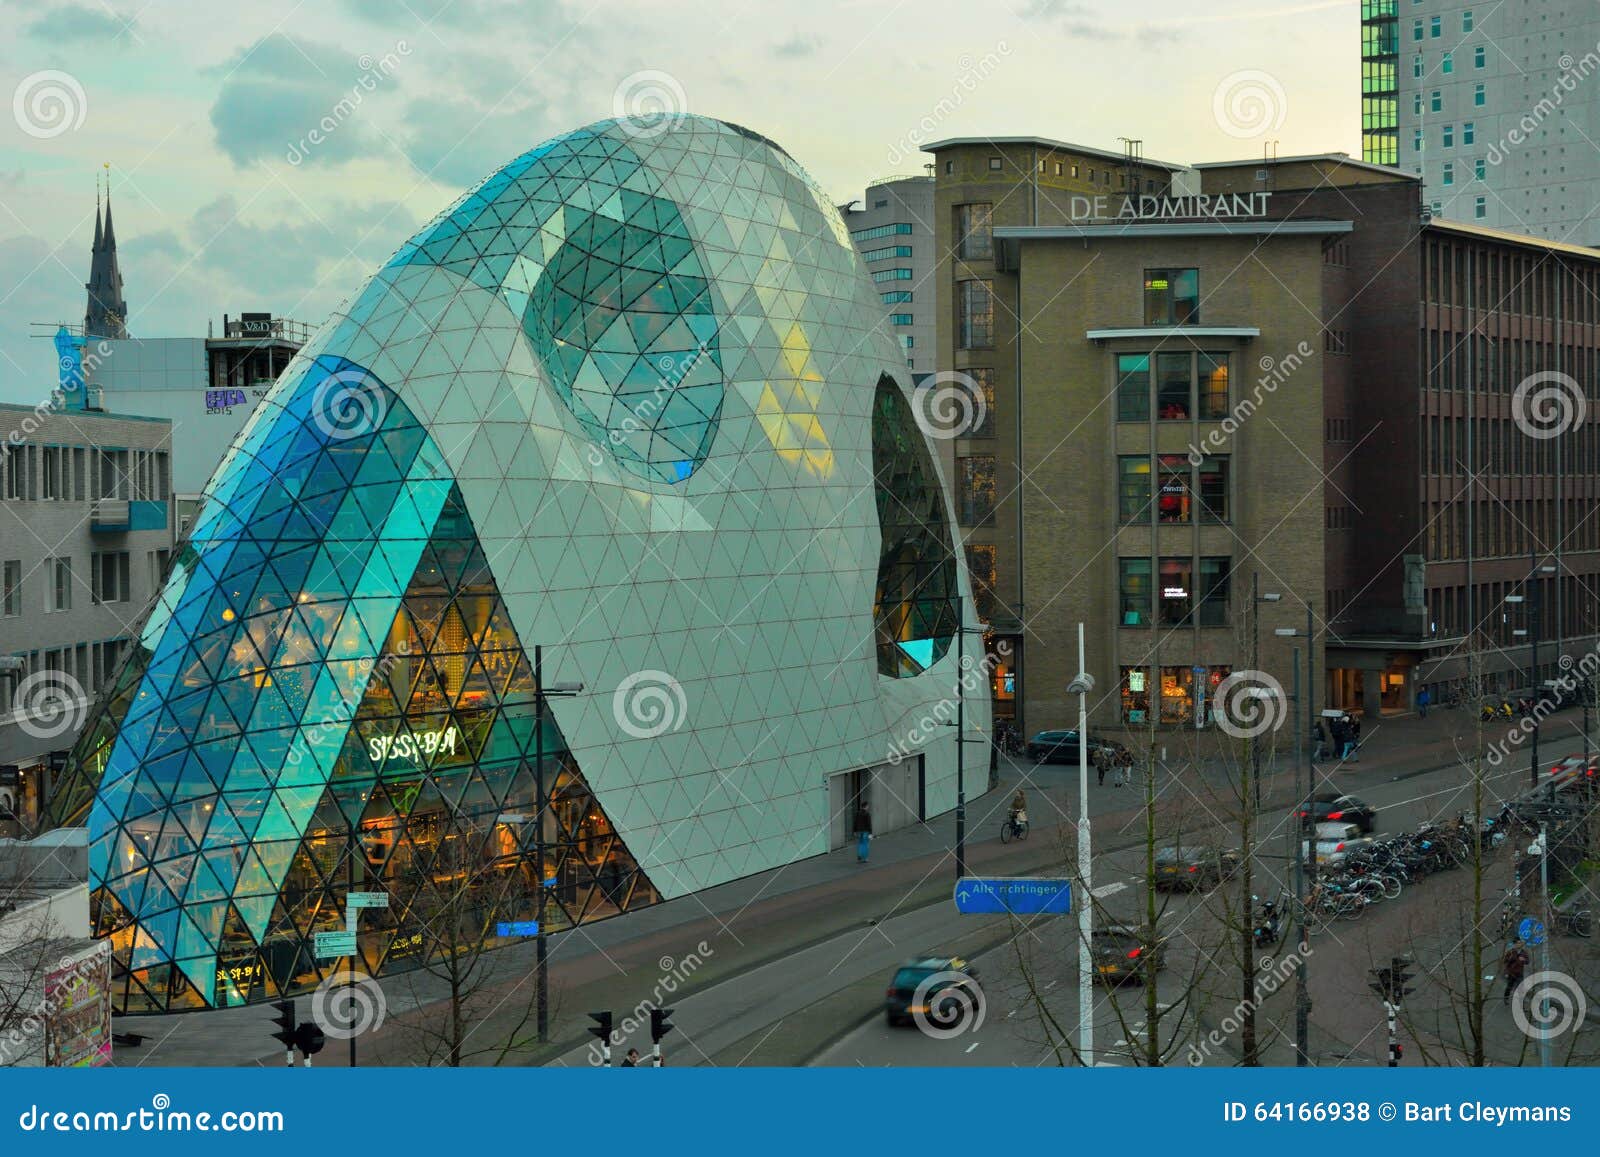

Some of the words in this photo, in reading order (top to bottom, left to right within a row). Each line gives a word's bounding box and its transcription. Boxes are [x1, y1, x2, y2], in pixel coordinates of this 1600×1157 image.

[1071, 196, 1107, 220] DE
[1118, 192, 1273, 218] ADMIRANT
[244, 321, 270, 332] V&D
[206, 407, 232, 415] 2015
[973, 884, 994, 894] Alle
[1000, 884, 1057, 896] richtingen
